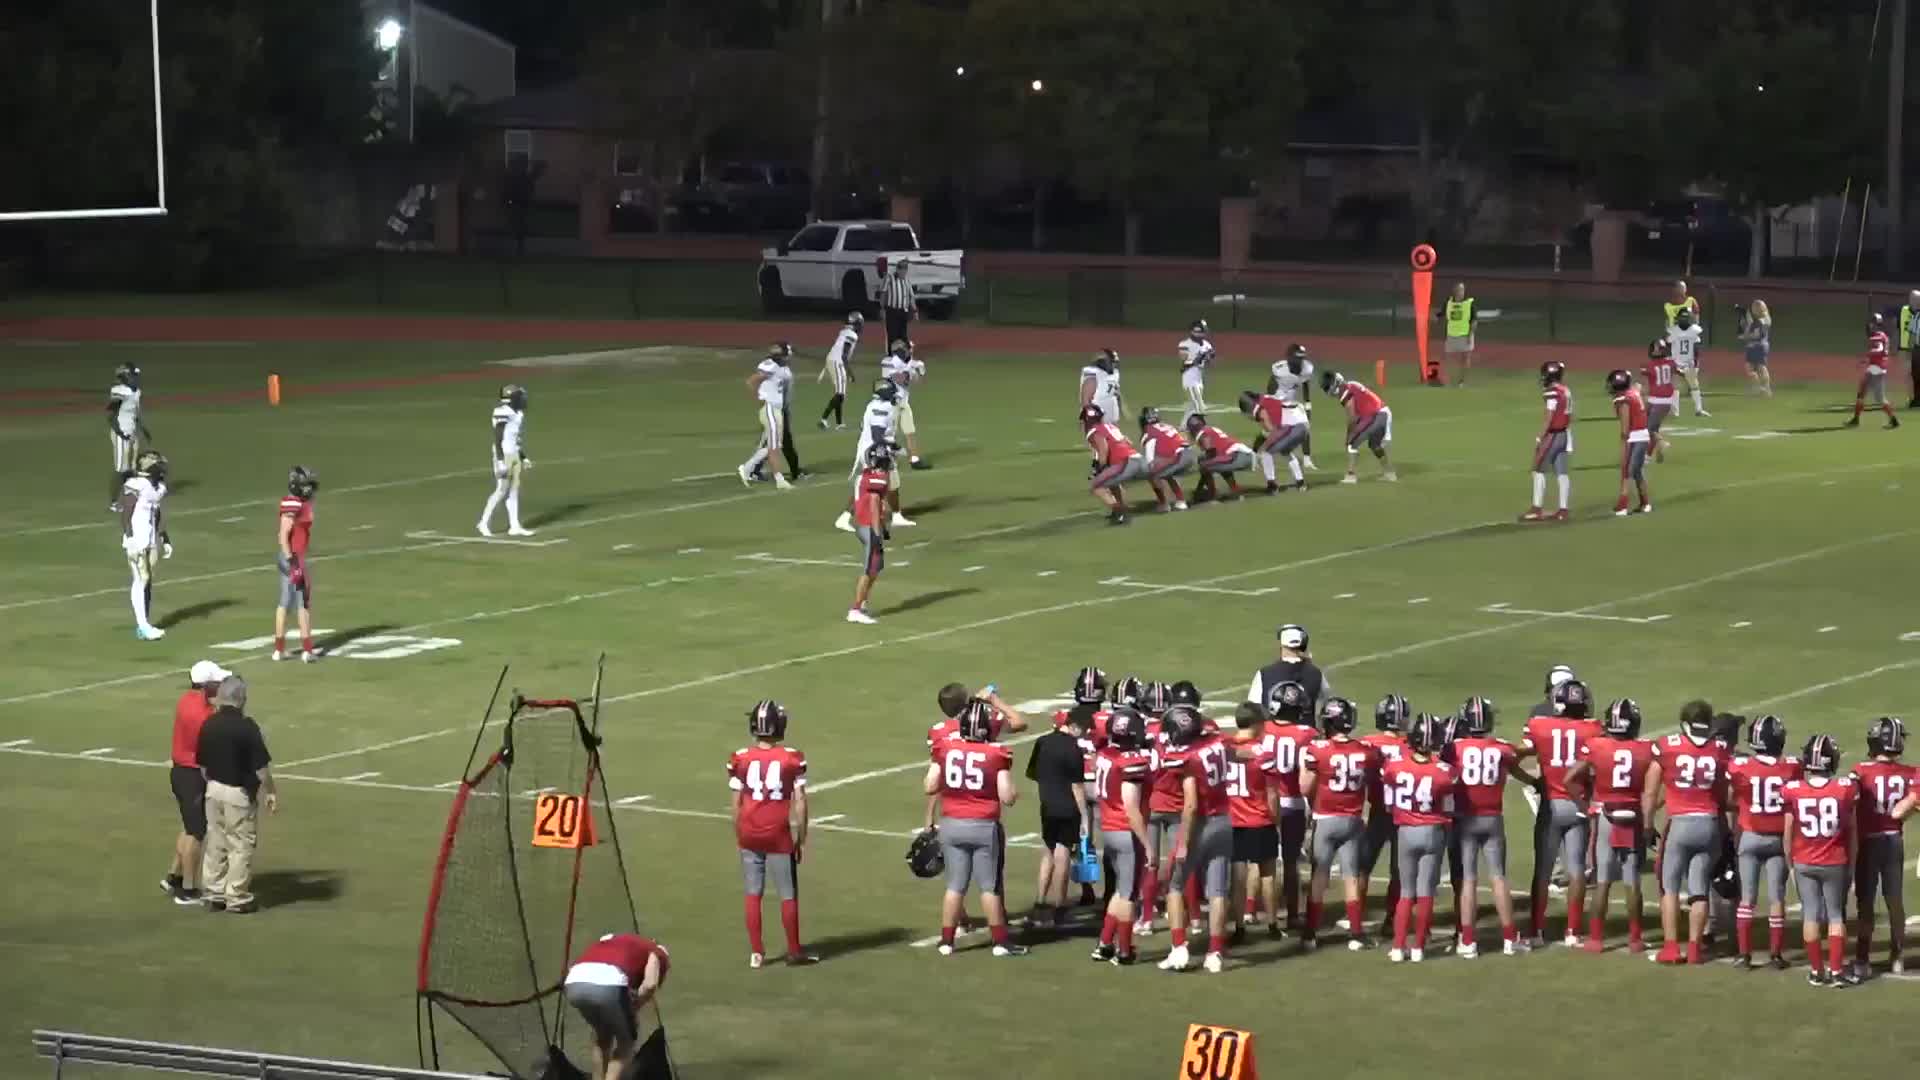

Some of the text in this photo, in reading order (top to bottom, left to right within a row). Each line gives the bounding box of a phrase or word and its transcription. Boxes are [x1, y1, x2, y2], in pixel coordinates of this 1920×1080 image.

[1679, 340, 1690, 355] 13
[1655, 364, 1671, 385] 10
[1462, 747, 1501, 786] 88
[1550, 728, 1577, 767] 11
[746, 760, 783, 800] 44
[945, 750, 987, 790] 65
[1329, 753, 1366, 792] 35
[1612, 749, 1632, 788] 2
[1675, 754, 1716, 788] 33
[1396, 772, 1433, 812] 24
[1749, 776, 1784, 813] 16
[1874, 775, 1905, 814] 12
[538, 795, 579, 837] 20
[1797, 797, 1839, 838] 58
[1187, 1027, 1239, 1080] 30
